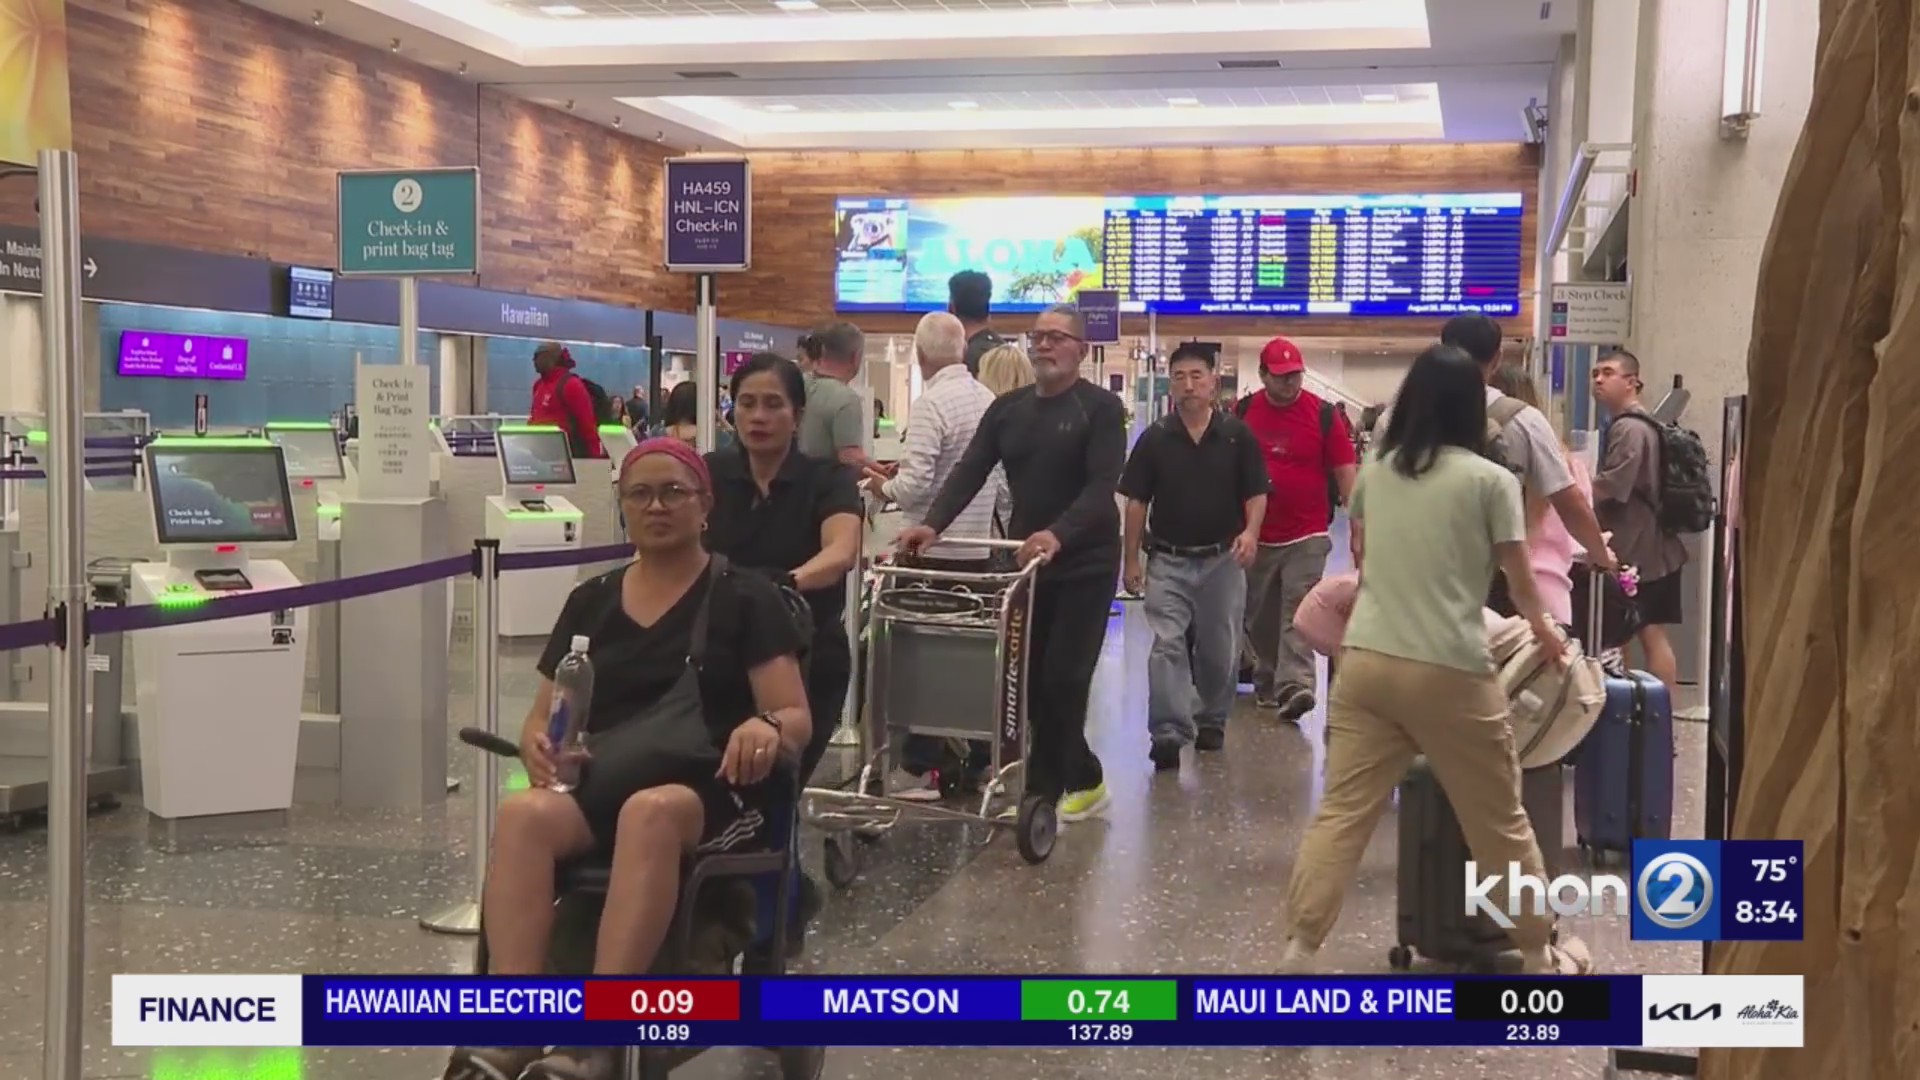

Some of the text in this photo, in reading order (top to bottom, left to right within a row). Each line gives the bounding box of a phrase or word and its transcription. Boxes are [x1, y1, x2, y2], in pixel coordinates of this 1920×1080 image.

[401, 185, 414, 206] 2
[683, 181, 731, 195] HA459
[367, 219, 449, 237] Check-in &
[675, 218, 738, 232] Check-In
[6, 240, 43, 258] Mainla
[362, 240, 455, 261] print bag tag
[13, 261, 41, 279] Next
[501, 303, 550, 328] Hawaiian
[386, 391, 409, 401] Print
[374, 405, 412, 416] Bag Tags
[170, 517, 224, 526] Print Bag Tags
